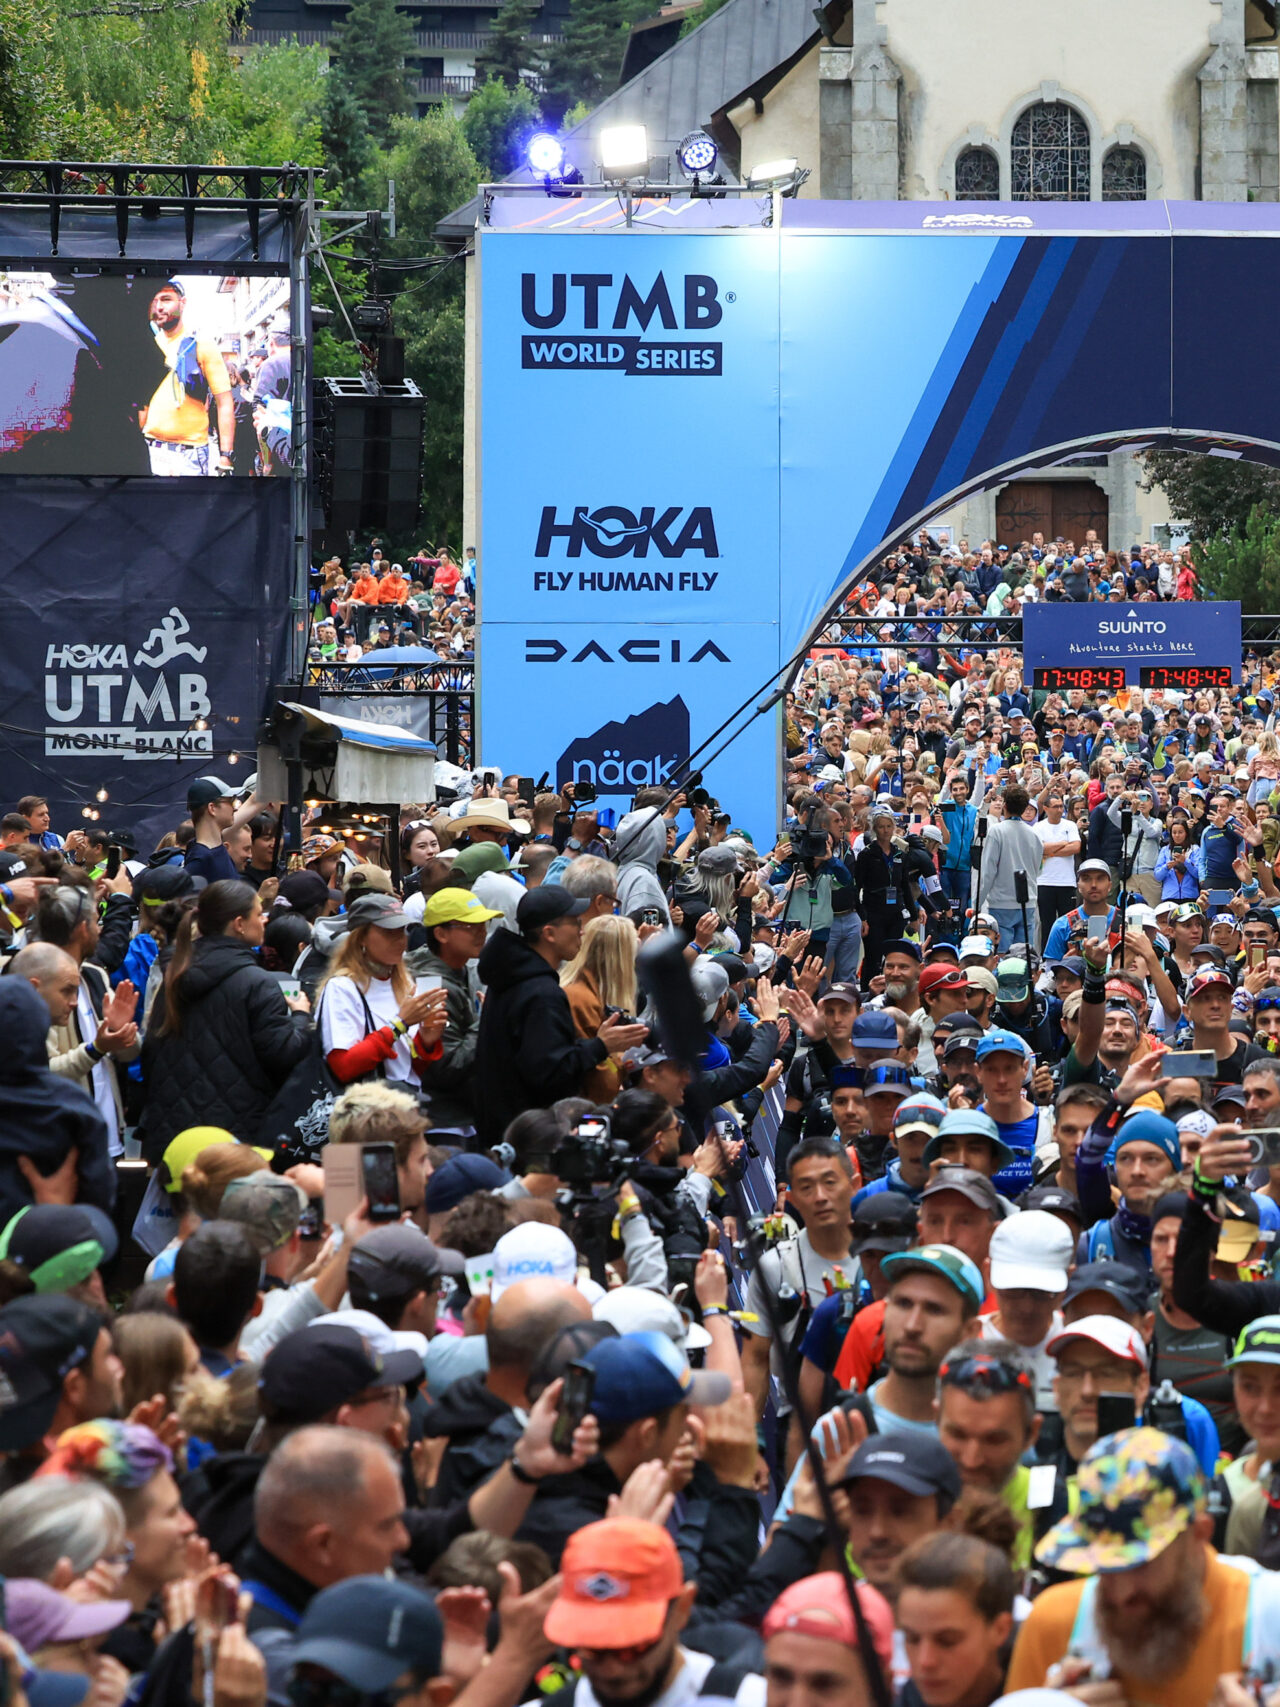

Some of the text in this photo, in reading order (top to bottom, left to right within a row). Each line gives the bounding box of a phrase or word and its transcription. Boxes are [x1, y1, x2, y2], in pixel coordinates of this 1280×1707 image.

[922, 214, 1034, 223] HOKA
[530, 342, 716, 369] WORLD SERIES
[534, 505, 720, 559] HOKA
[534, 572, 719, 592] FLY HUMAN FLY
[1098, 621, 1167, 634] SUUNTO
[46, 644, 129, 668] HOKA
[525, 639, 731, 662] DACIA
[1041, 669, 1125, 689] 17:48:43
[1149, 667, 1232, 687] 17:48:42
[45, 671, 212, 724] UTMB
[51, 733, 207, 754] MONT-BLANC
[572, 749, 678, 786] näak
[508, 1261, 554, 1275] HOKA
